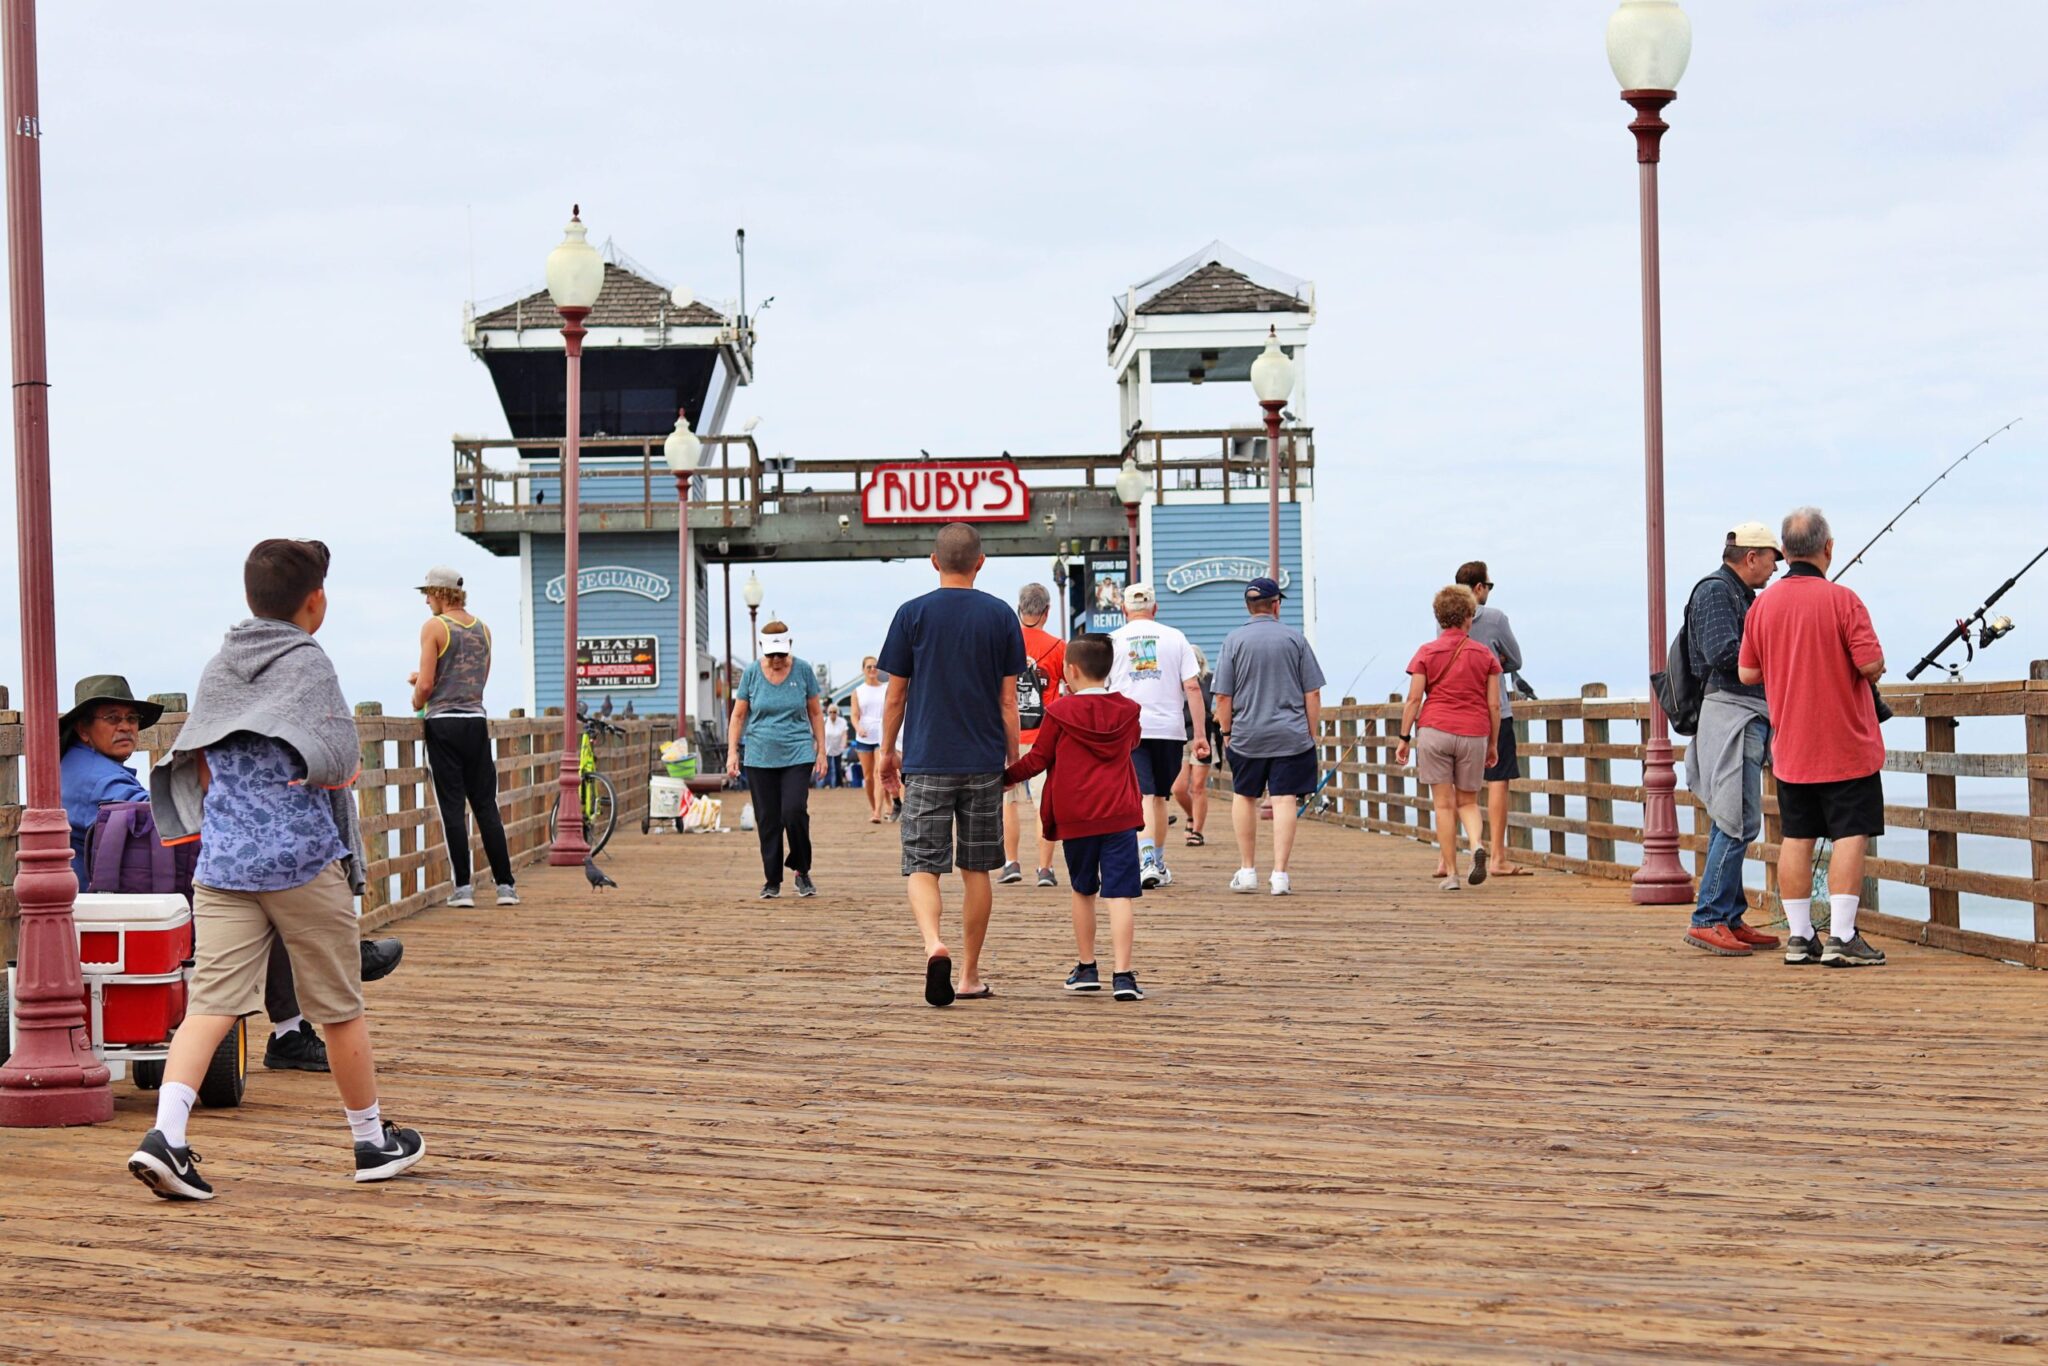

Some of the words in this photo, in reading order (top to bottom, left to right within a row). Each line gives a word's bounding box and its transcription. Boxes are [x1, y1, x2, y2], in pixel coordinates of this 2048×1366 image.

[884, 470, 1013, 512] RUBY'S
[1180, 562, 1224, 585] BAIT
[556, 571, 660, 597] LFEGUARD
[577, 639, 649, 650] PLEASE
[592, 654, 632, 664] RULES
[596, 677, 620, 685] THE
[626, 676, 651, 684] PIER
